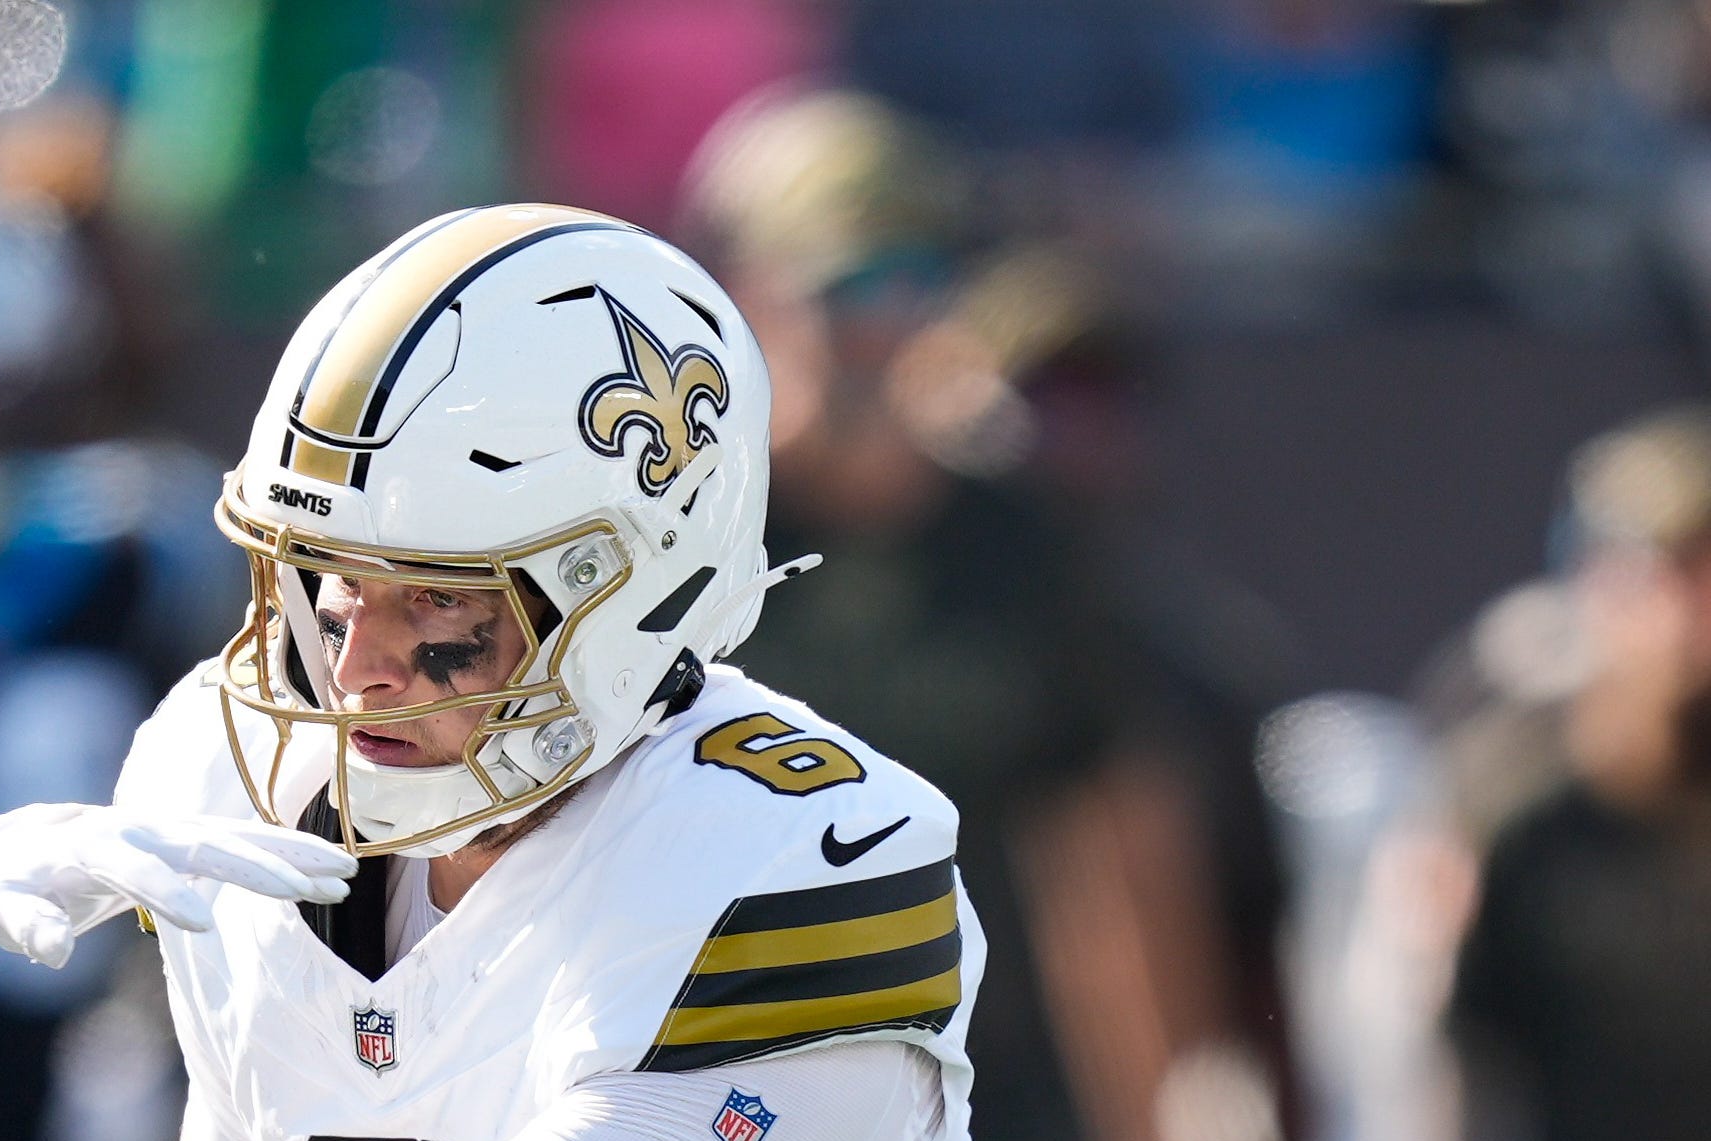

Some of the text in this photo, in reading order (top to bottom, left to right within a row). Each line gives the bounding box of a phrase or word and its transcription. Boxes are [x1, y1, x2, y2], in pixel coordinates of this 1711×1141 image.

[268, 483, 333, 517] SAINTS
[693, 711, 868, 797] 6
[357, 1033, 392, 1064] NFL
